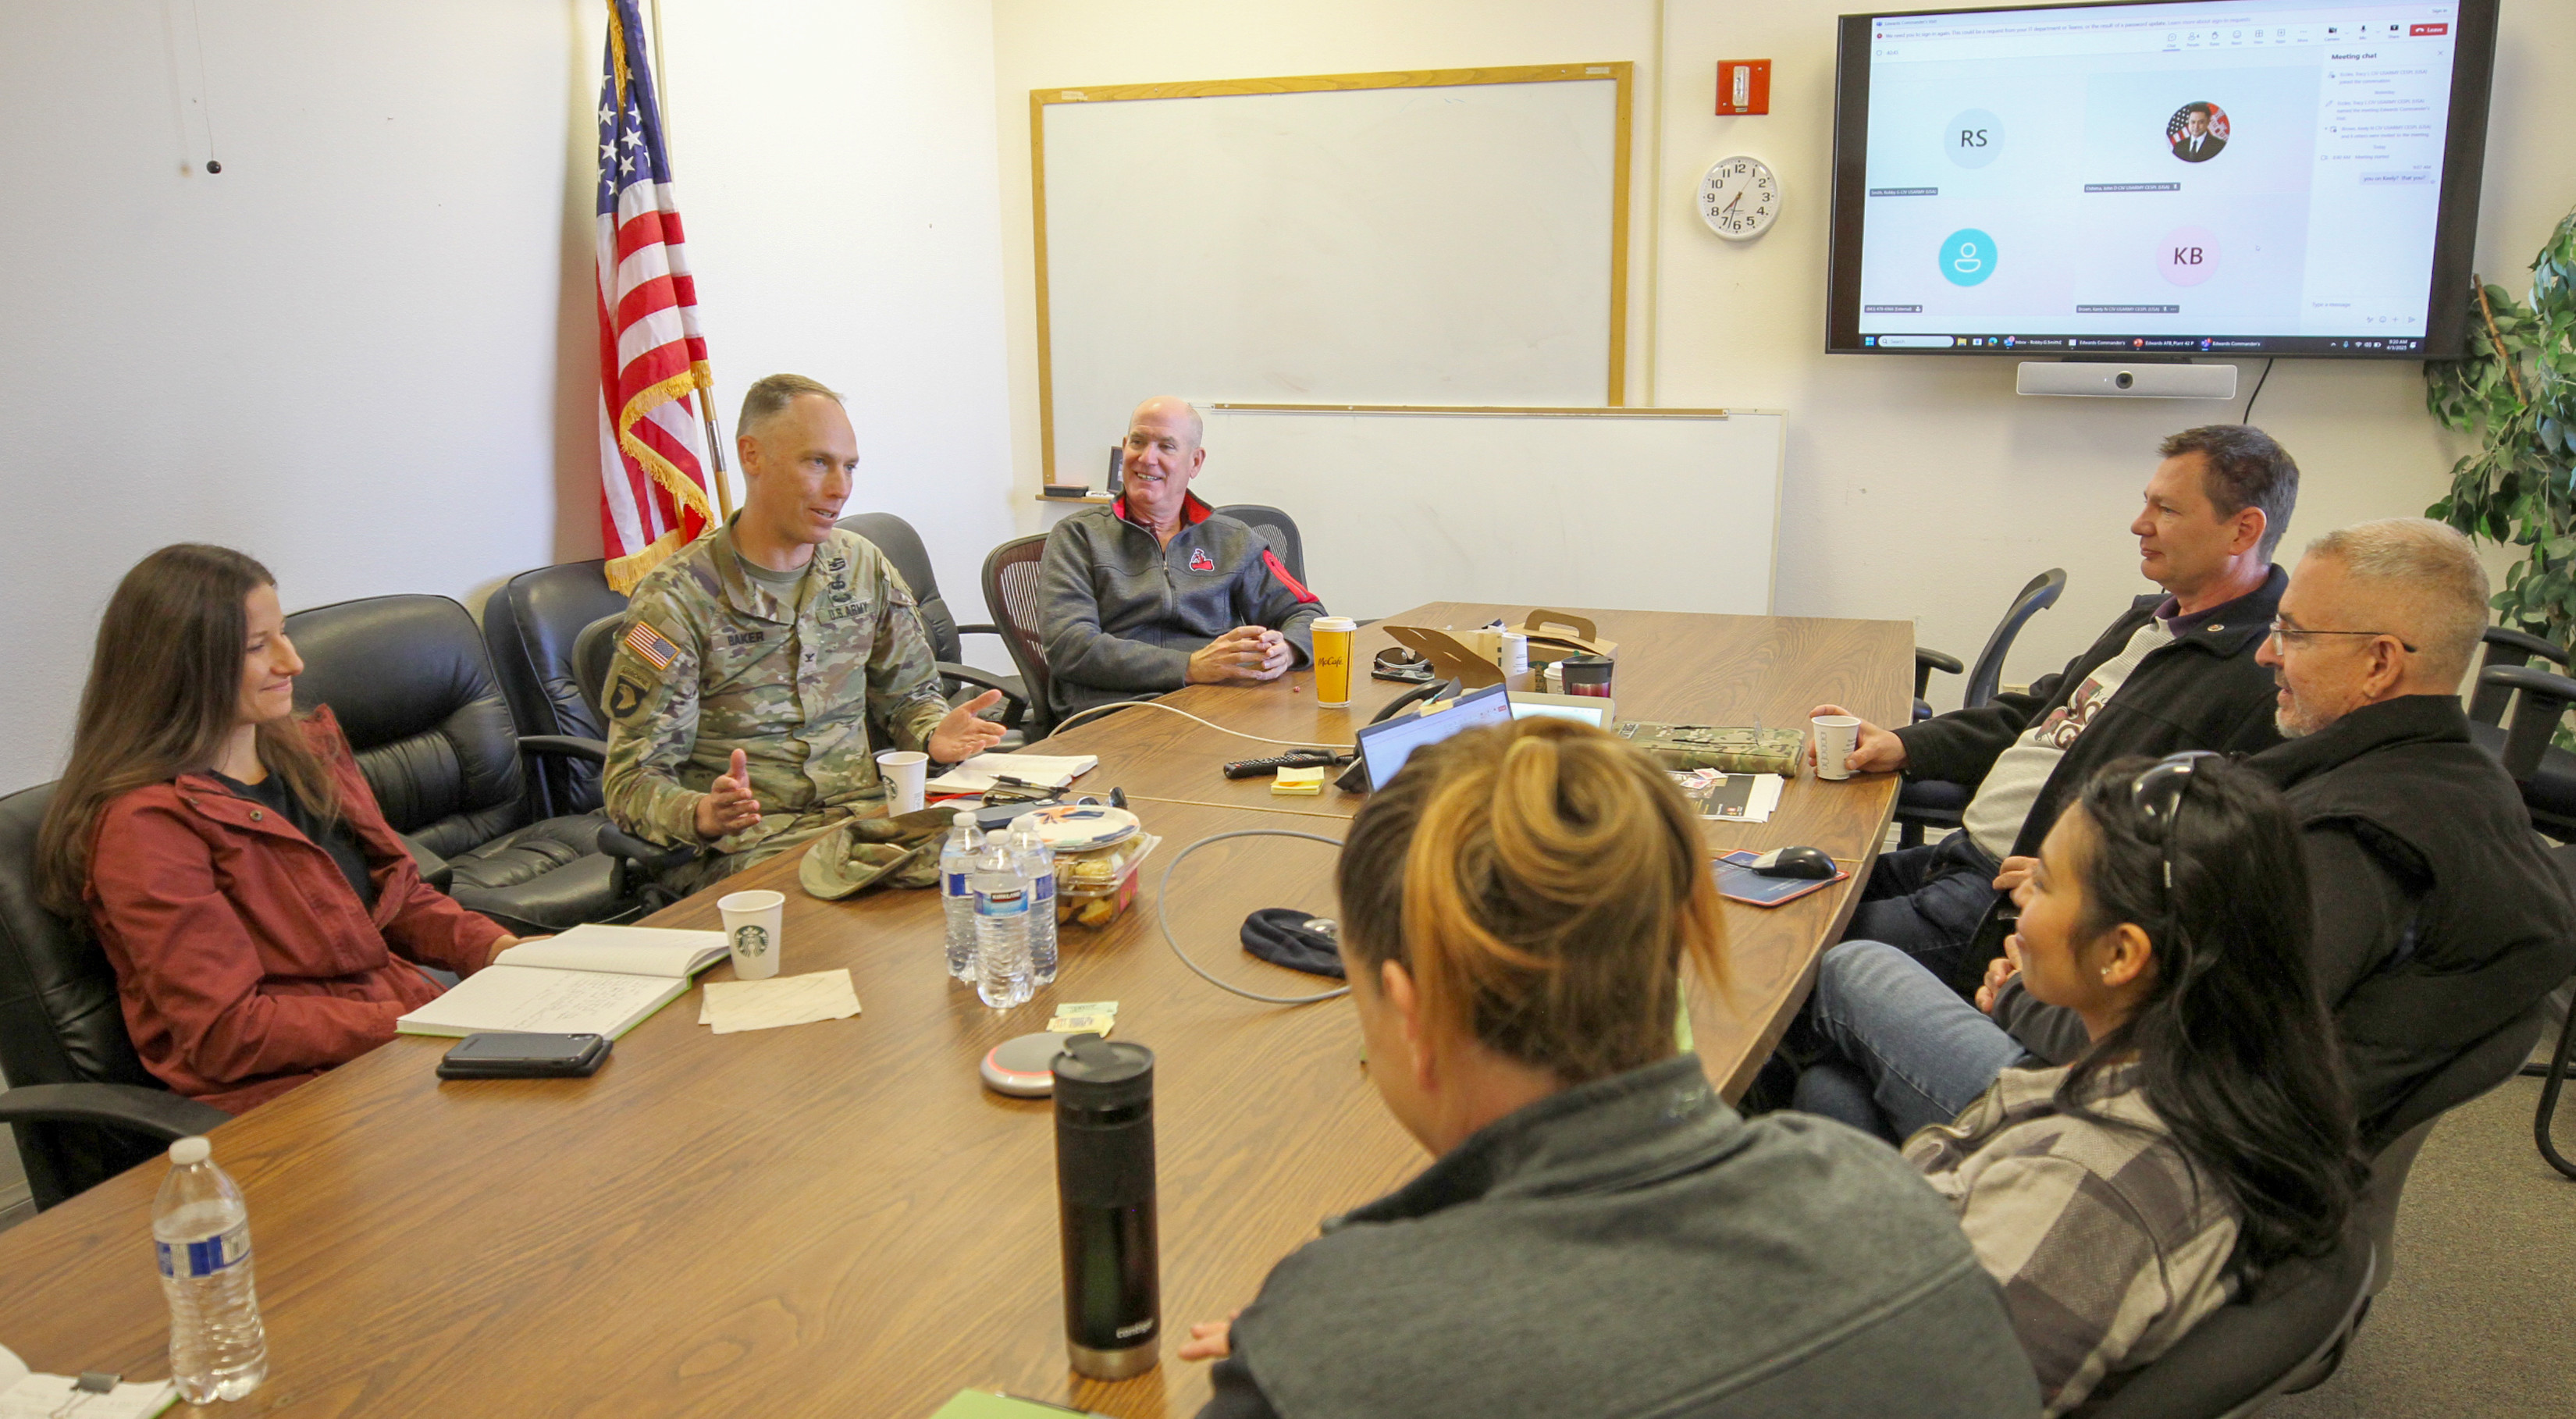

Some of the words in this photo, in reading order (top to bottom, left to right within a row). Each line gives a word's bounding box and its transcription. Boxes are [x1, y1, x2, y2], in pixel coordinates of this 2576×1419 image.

[1960, 129, 1988, 148] RS
[1722, 169, 1730, 178] 11
[1735, 164, 1746, 173] 12
[1752, 168, 1755, 177] 1
[1711, 179, 1723, 189] 10
[1758, 178, 1766, 188] 2
[1707, 193, 1715, 203] 9
[1762, 192, 1770, 202] 3
[1711, 206, 1719, 216] 8
[1756, 206, 1765, 216] 4
[1721, 216, 1729, 226] 7
[1733, 220, 1741, 230] 6
[1746, 216, 1755, 226] 5
[2174, 247, 2203, 265] KB
[728, 631, 764, 647] BAKER
[992, 891, 1021, 900] KIRKLAND
